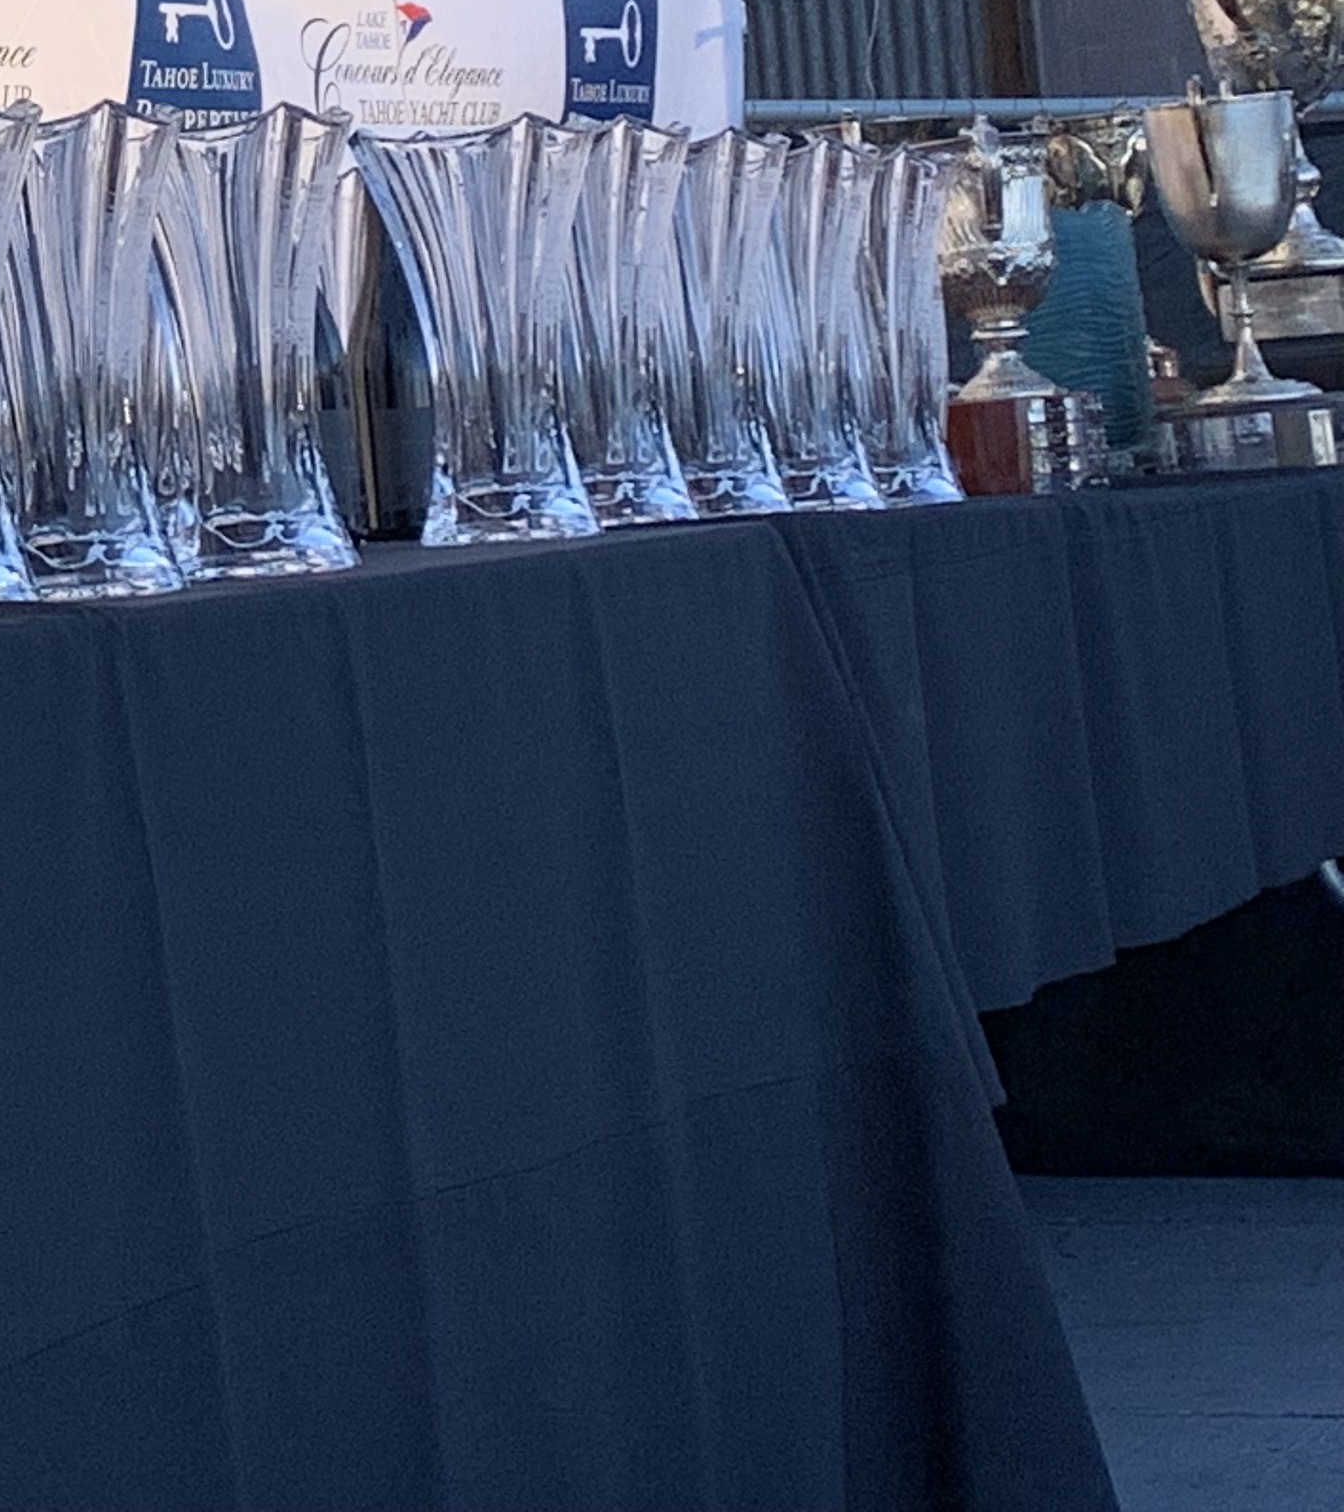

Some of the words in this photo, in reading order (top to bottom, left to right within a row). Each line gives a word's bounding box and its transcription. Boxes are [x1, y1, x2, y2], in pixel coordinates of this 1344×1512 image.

[140, 60, 198, 89] TAHOE
[359, 100, 406, 126] TAHOE
[409, 101, 459, 126] YACHT
[462, 102, 502, 126] CLUB
